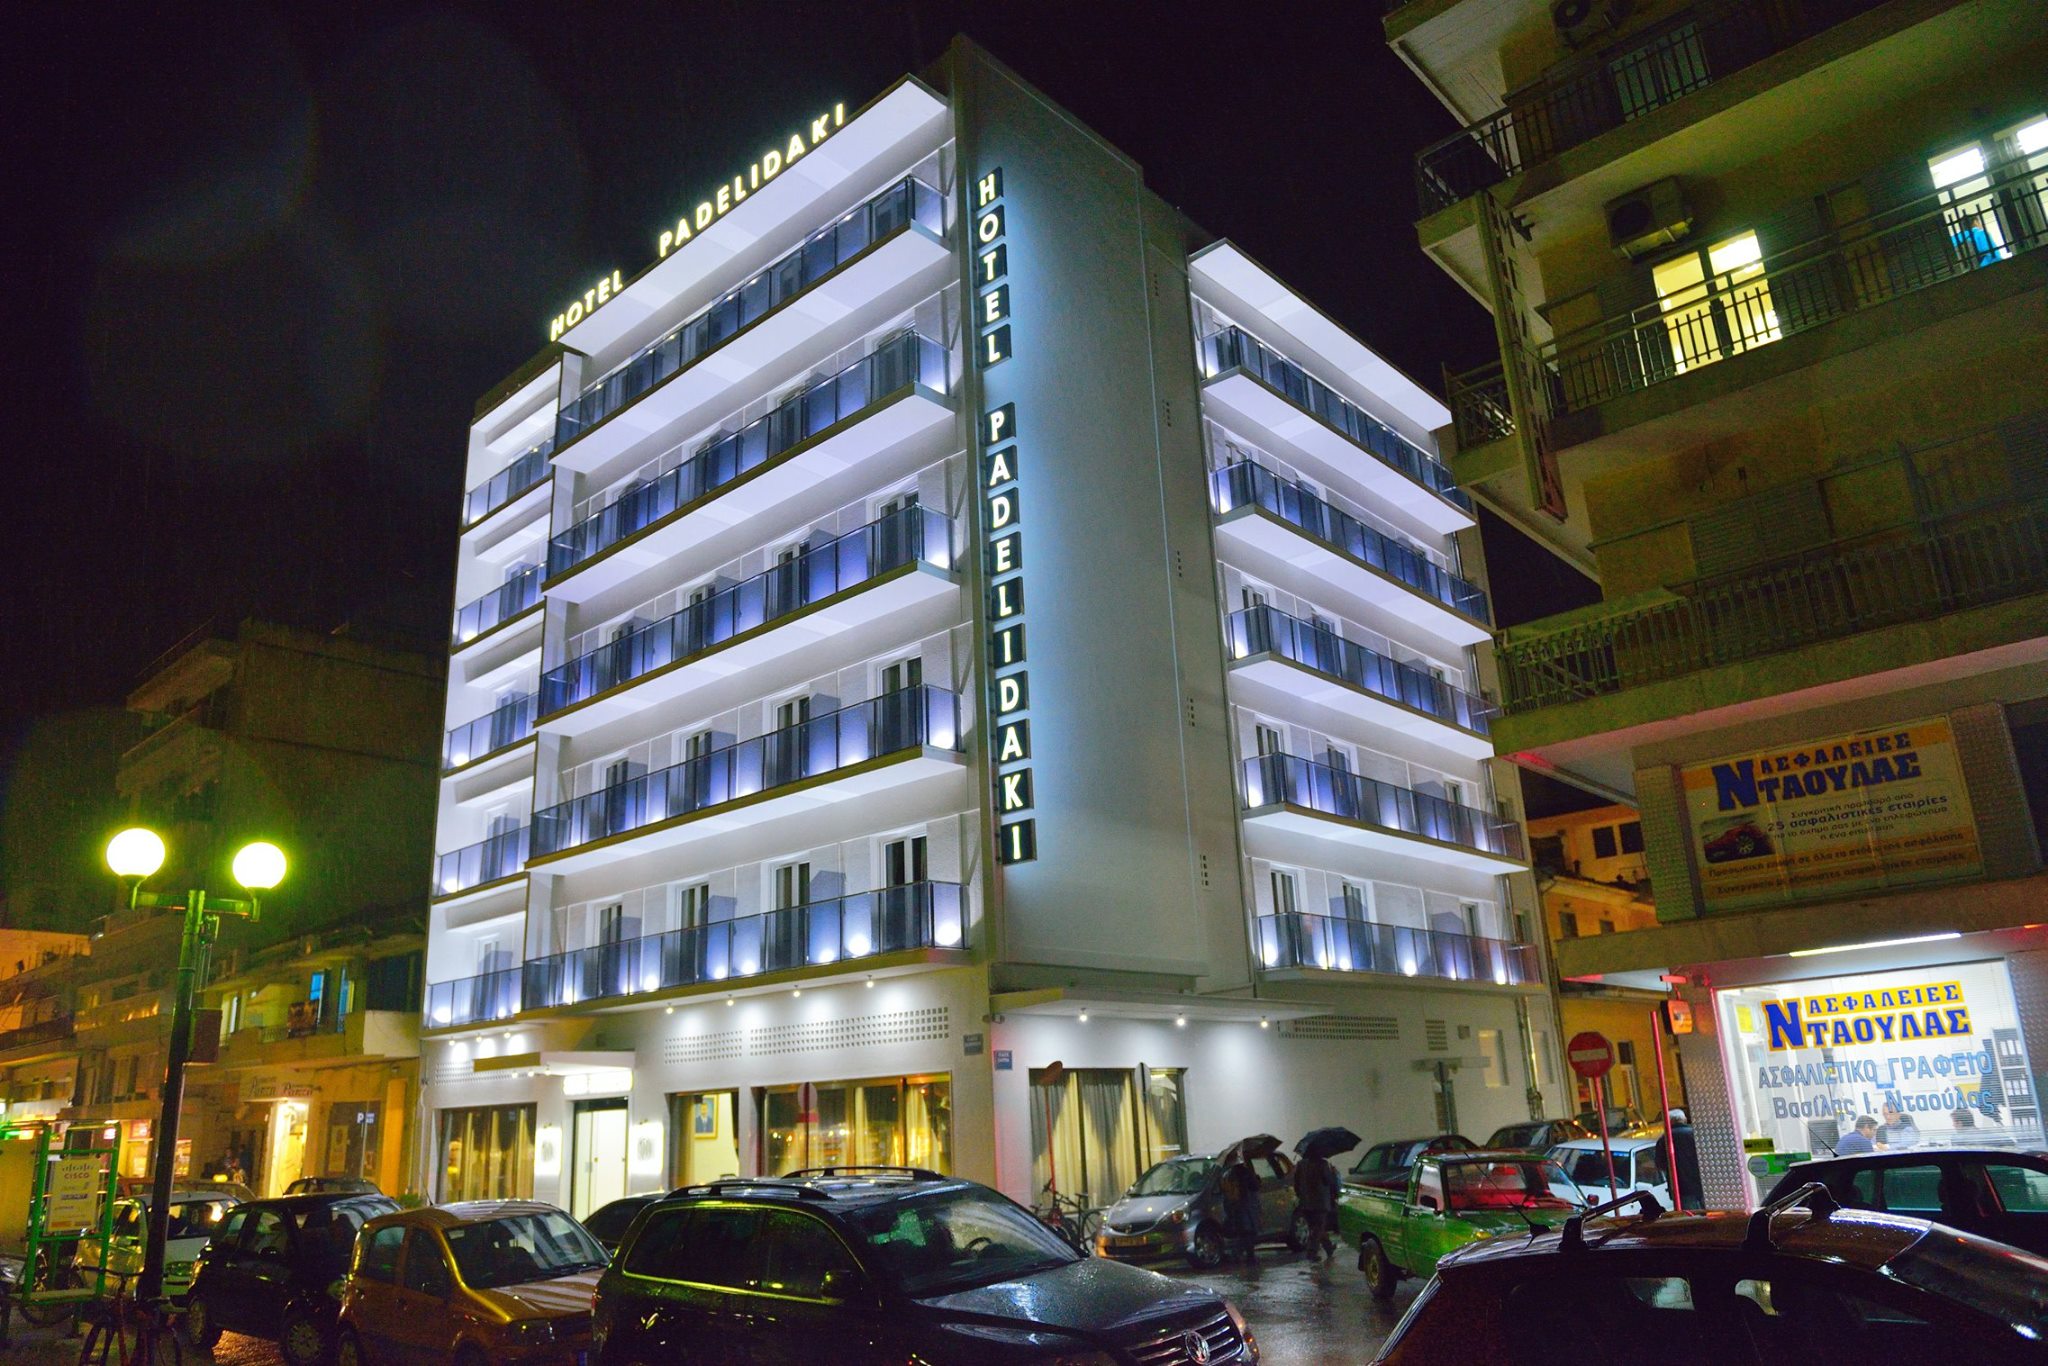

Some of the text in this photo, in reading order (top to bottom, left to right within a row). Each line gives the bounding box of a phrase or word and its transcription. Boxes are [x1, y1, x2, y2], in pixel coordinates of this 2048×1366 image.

[551, 104, 845, 342] HOTEL PADELIDAKI
[979, 173, 1023, 861] HOTEL PADELIDAKI
[1761, 733, 1912, 774] ΑΣΦΑΛΕΙΕΣ
[1712, 752, 1922, 811] ΝΤΑΟΥΛΑΣ
[1766, 820, 1785, 831] 25
[1809, 984, 1960, 1014] ΑΣΦΑΛΕΙΕΣ
[1765, 1001, 1970, 1048] ΝΤΑΟΥΛΑΣ
[1758, 1051, 1993, 1089] ΑΣΦΑΛΙΣΤΙΚΟ ΓΡΑΦΕΙΟ
[1773, 1094, 1857, 1122] Βασίλης
[1885, 1087, 1995, 1114] Νταούλας
[64, 1172, 90, 1180] CISCO
